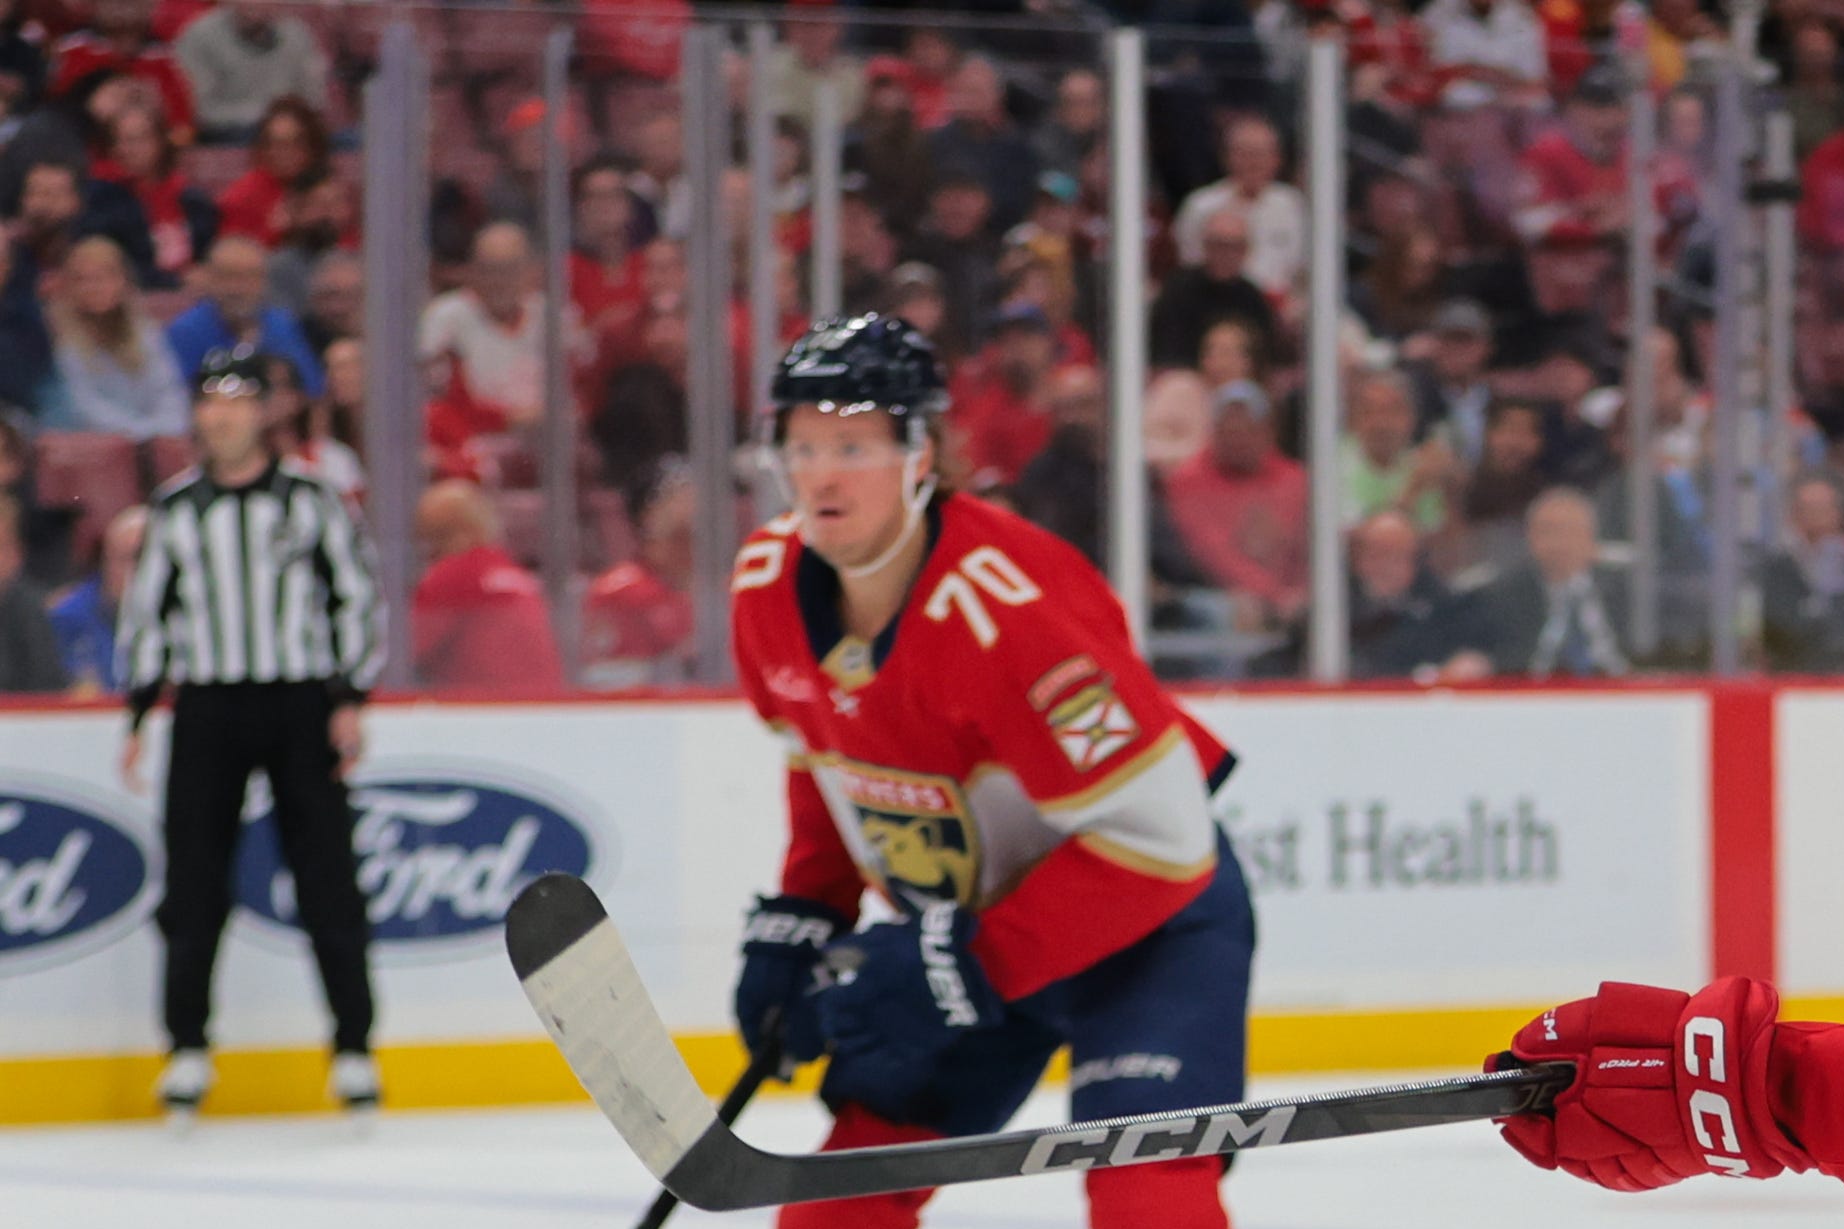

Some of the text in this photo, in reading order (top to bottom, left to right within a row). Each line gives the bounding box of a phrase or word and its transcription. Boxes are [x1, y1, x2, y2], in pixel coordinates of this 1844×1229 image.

[923, 545, 1043, 650] 70
[1327, 797, 1560, 891] Health
[1019, 1105, 1297, 1177] CCM
